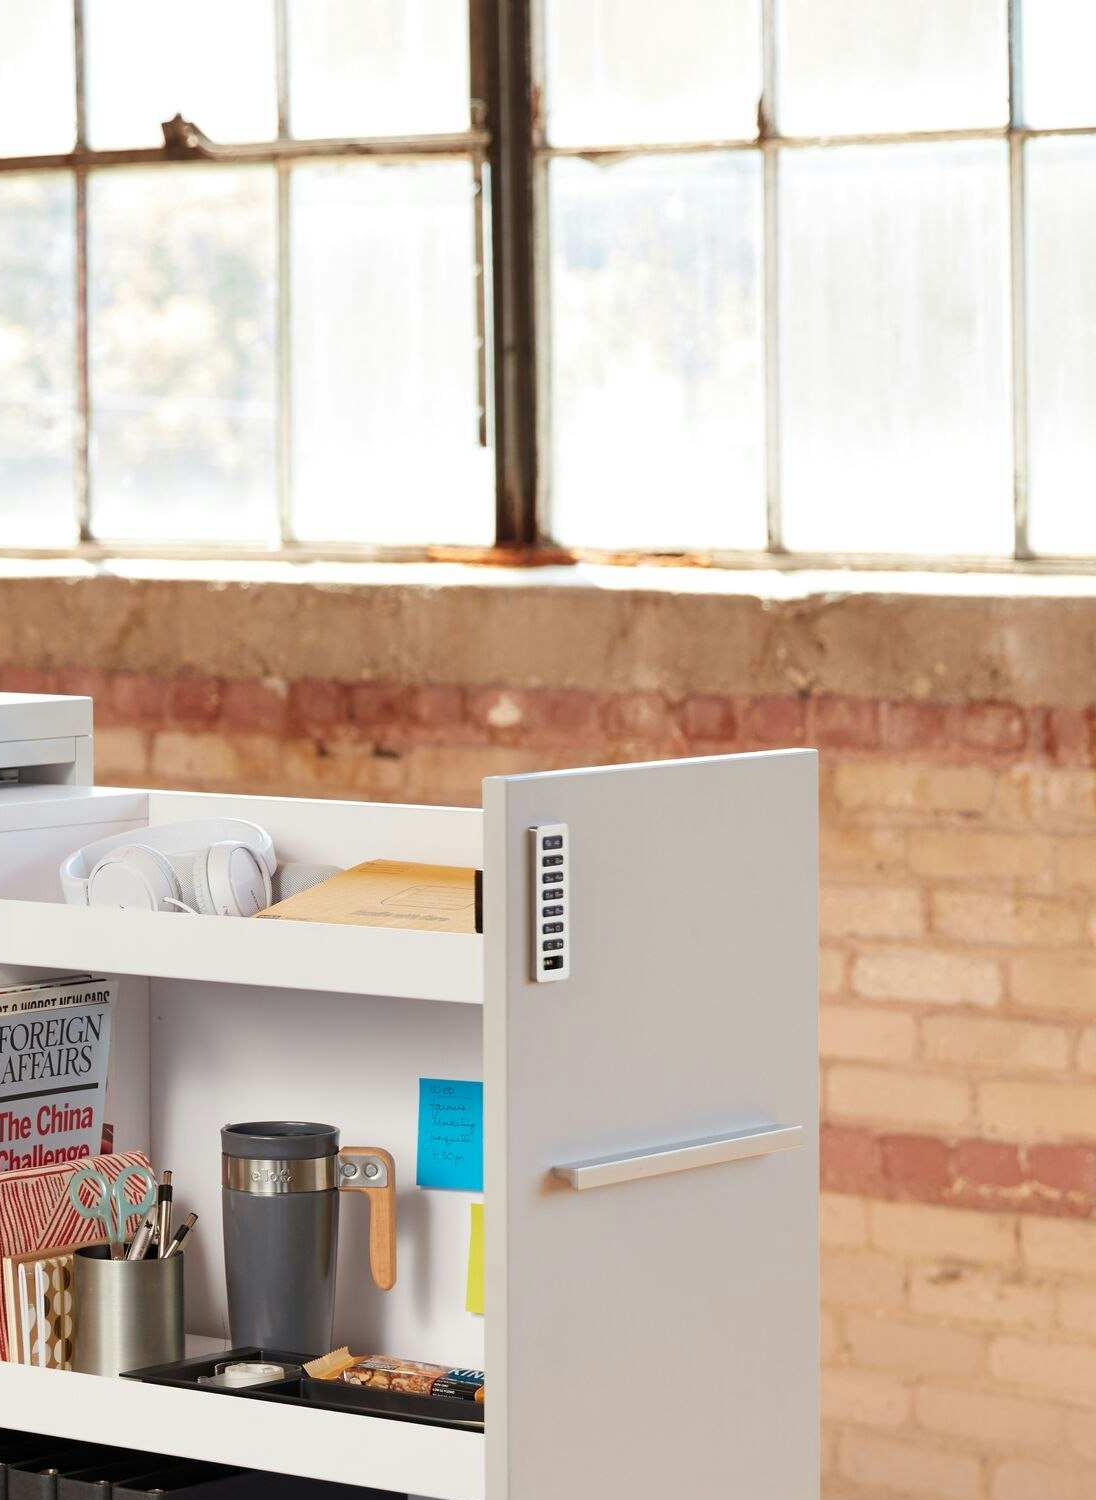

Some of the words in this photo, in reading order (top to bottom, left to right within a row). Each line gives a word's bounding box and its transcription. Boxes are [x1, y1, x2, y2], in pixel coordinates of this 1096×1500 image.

[0, 1045, 93, 1085] AFFAIRS
[36, 1103, 94, 1136] China
[447, 1367, 484, 1380] KIN
